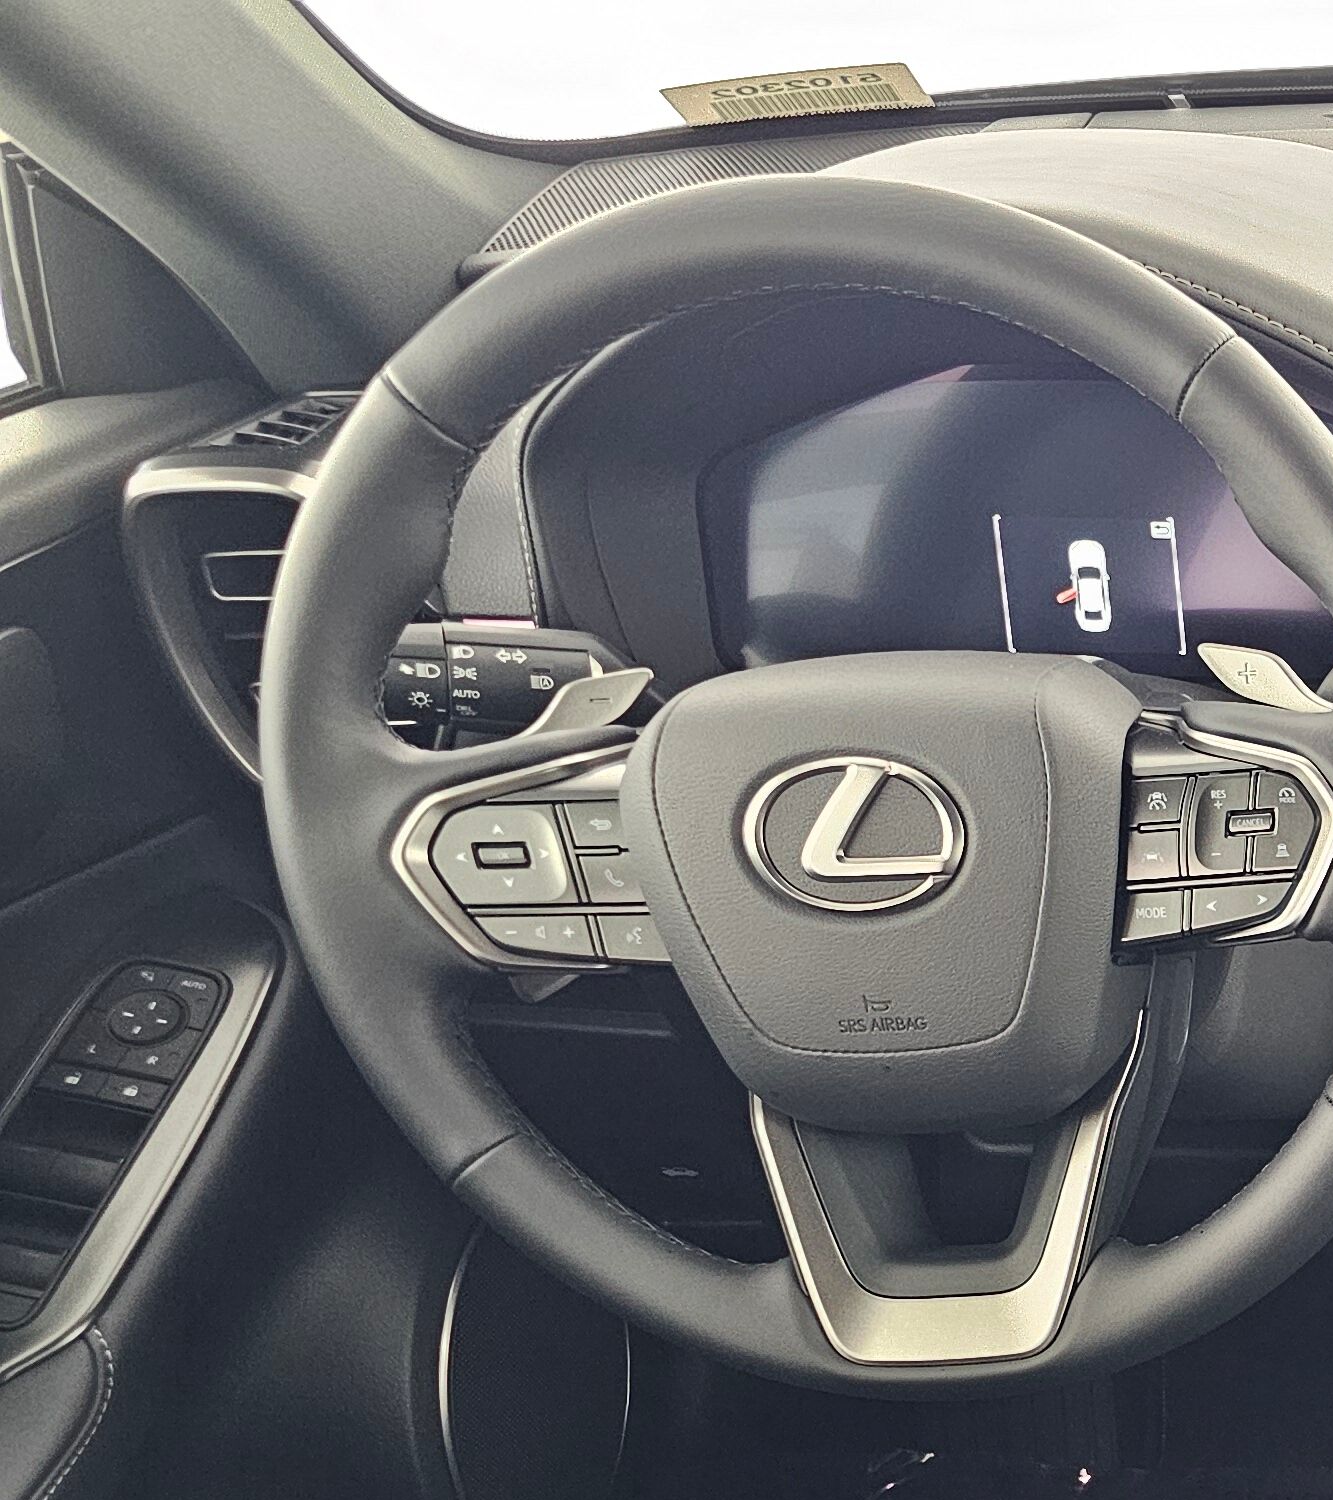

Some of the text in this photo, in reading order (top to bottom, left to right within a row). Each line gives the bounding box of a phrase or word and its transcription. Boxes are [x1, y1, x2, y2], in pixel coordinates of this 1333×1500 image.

[452, 688, 481, 699] AUTO
[1210, 789, 1227, 799] RES
[1135, 906, 1168, 919] MODE
[180, 979, 208, 991] AUTO
[838, 1016, 928, 1033] SRS AIRBAG
